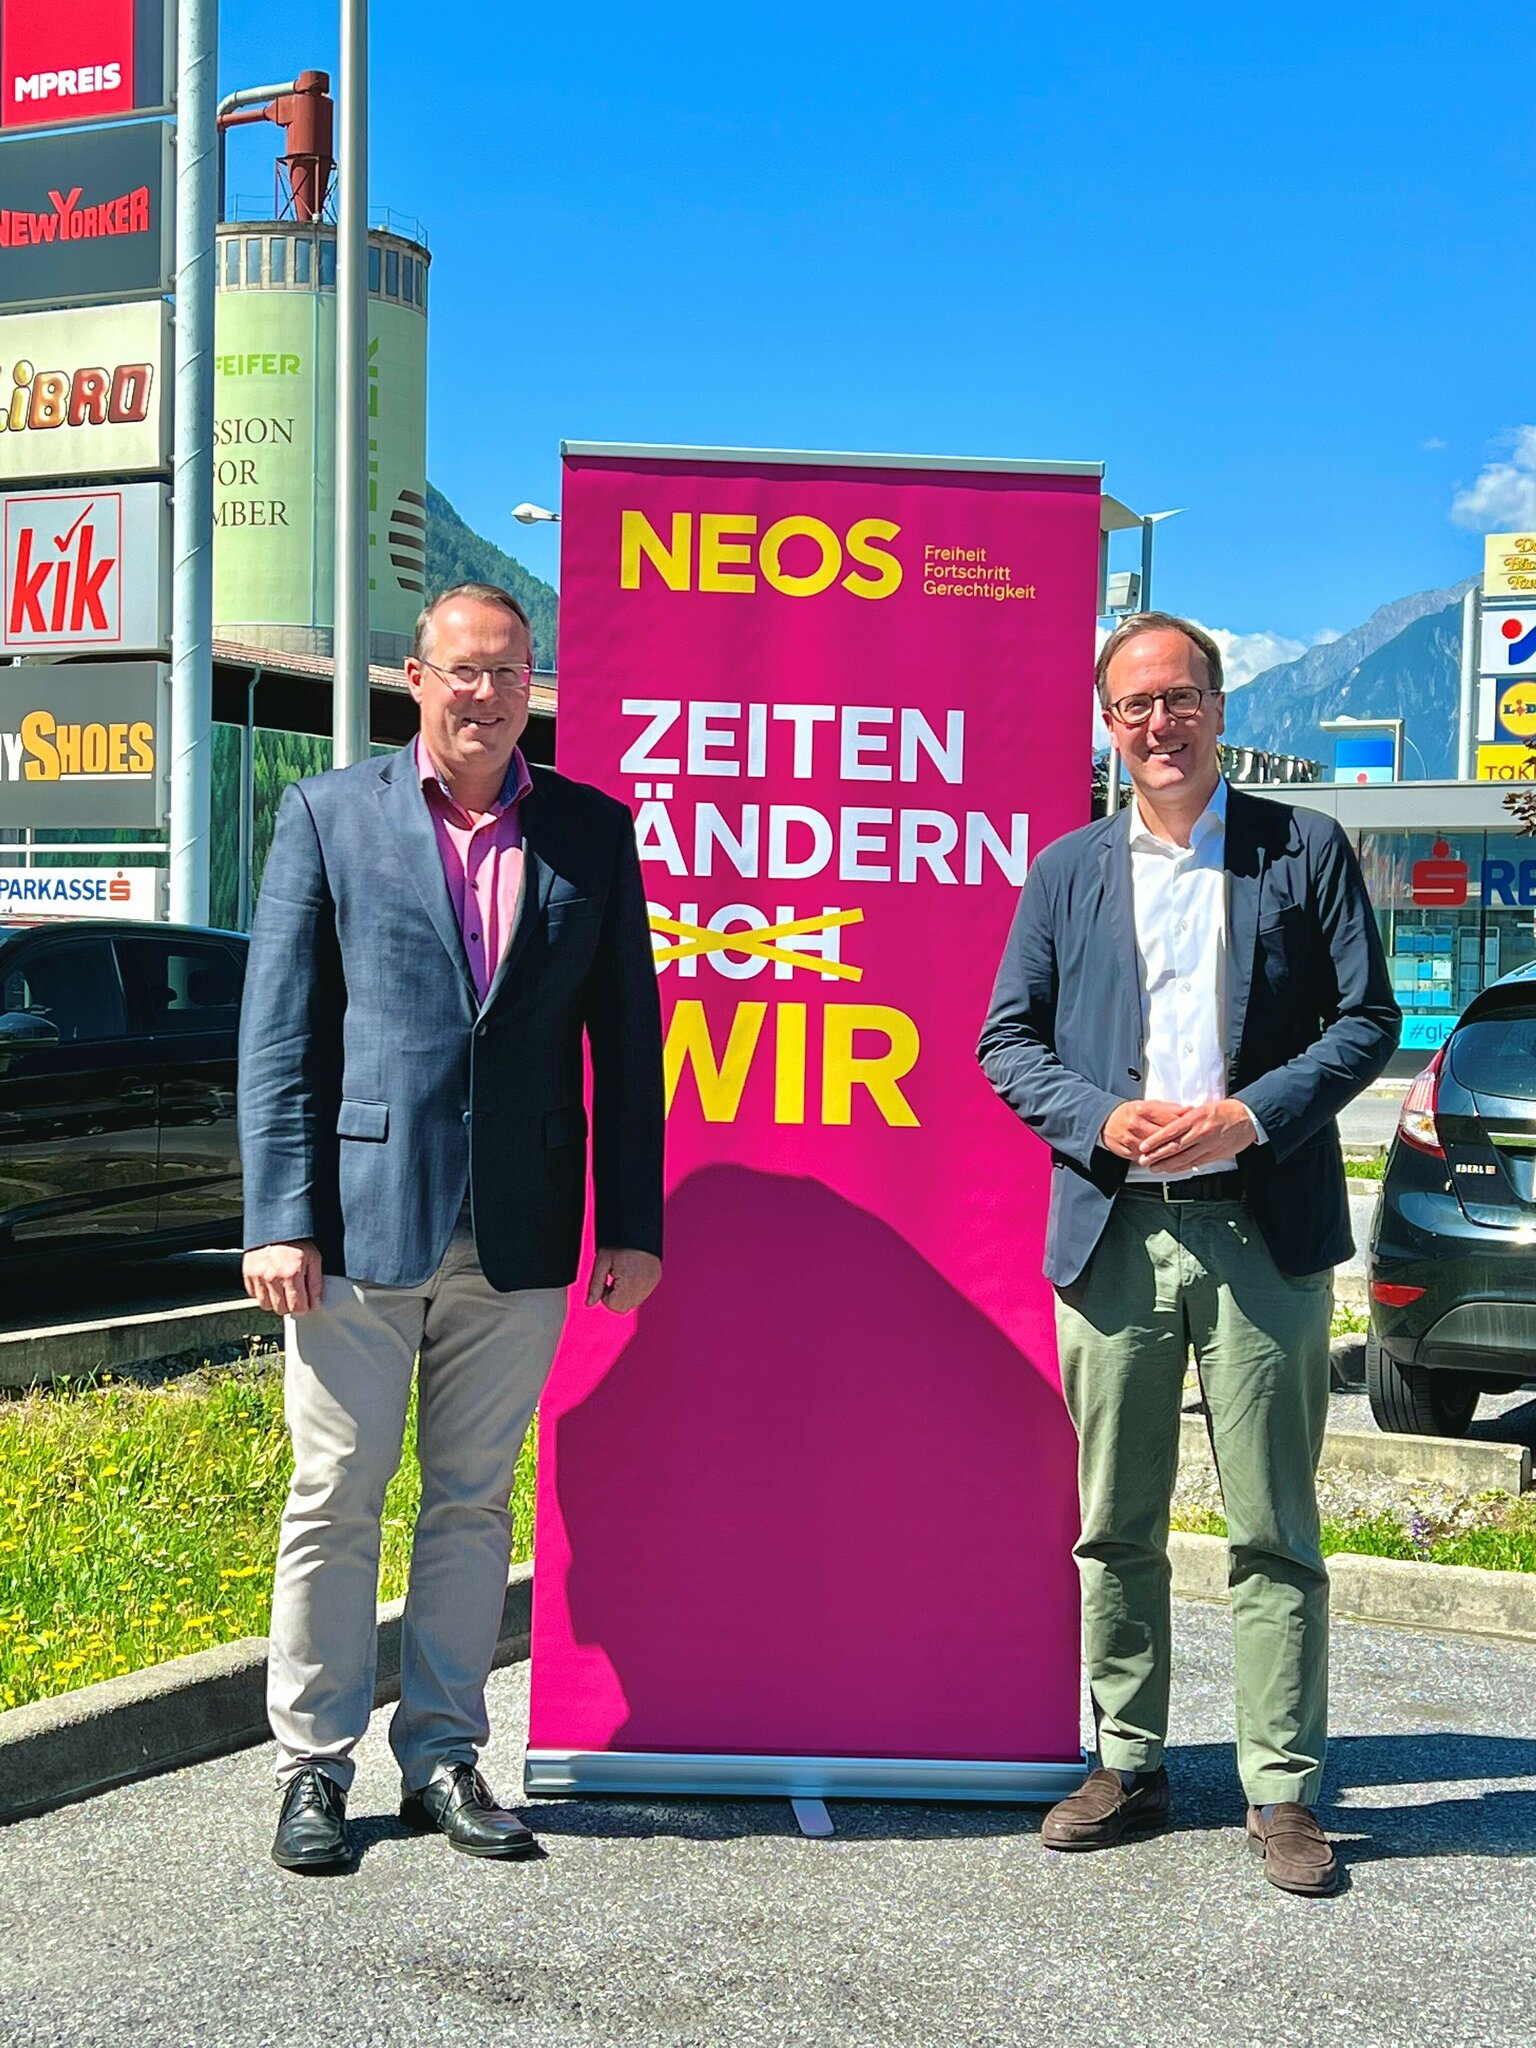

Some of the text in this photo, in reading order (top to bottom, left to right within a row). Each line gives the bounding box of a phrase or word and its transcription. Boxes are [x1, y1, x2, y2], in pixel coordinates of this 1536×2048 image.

[14, 62, 121, 103] MPREIS
[213, 459, 259, 488] OR
[620, 510, 903, 599] NEOS
[924, 545, 987, 562] Freiheit
[924, 562, 1011, 580] Fortschritt
[923, 580, 1036, 601] Gerechtigkeit
[619, 699, 965, 784] ZEITEN
[633, 782, 1029, 887] ÄNDERN
[663, 999, 921, 1127] WIR
